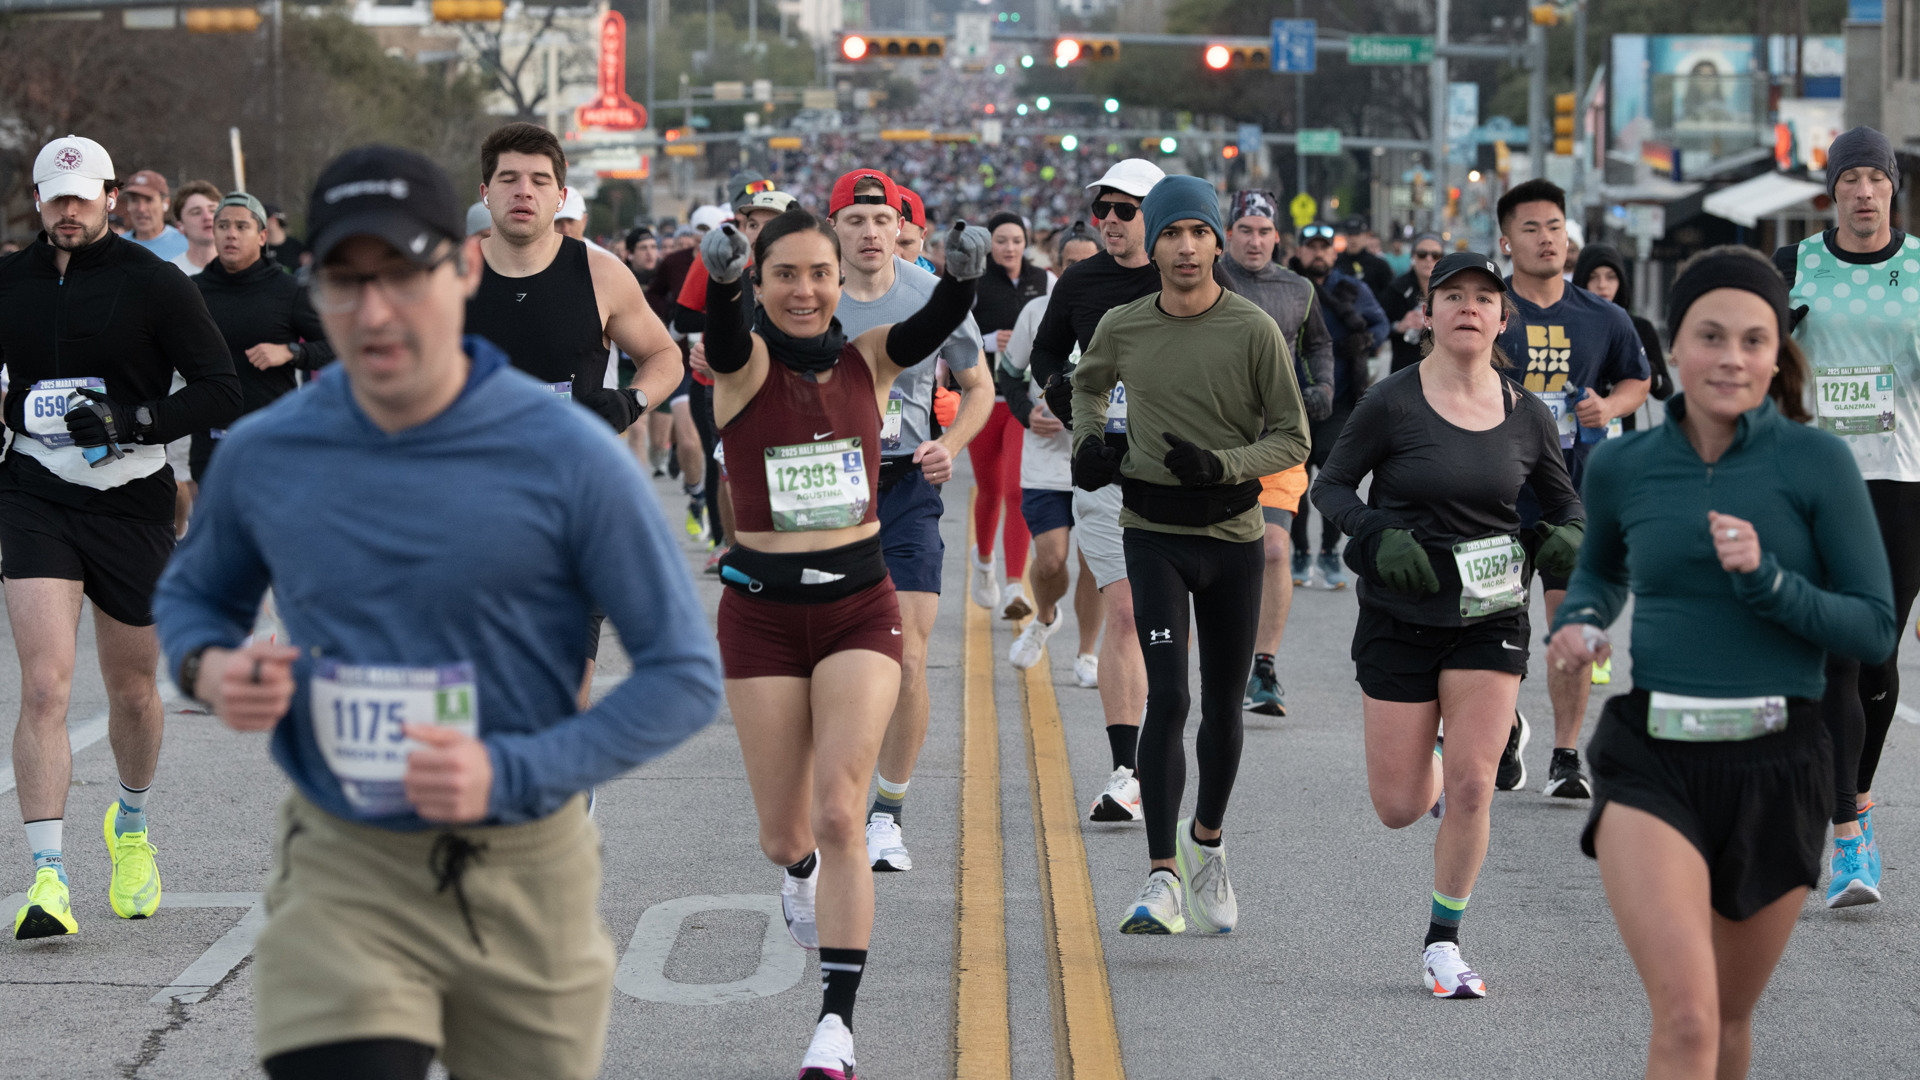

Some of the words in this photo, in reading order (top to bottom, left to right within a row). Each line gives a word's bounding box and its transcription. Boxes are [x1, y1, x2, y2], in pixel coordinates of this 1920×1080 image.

[1358, 39, 1412, 58] Gibson
[602, 20, 620, 108] AUSTIN
[1840, 367, 1853, 375] HALF
[1853, 366, 1881, 374] MARATHON
[40, 380, 55, 389] 2025
[55, 379, 88, 388] MARATHON
[1822, 381, 1870, 402] 12734
[1834, 403, 1876, 411] GLANZMAN
[781, 447, 798, 457] 2025
[798, 445, 815, 455] HALF
[815, 441, 848, 454] MARATHON
[848, 453, 855, 467] C
[775, 462, 838, 492] 12393
[796, 489, 844, 501] AGUSTINA
[1464, 553, 1508, 583] 15253
[334, 699, 406, 742] 1175
